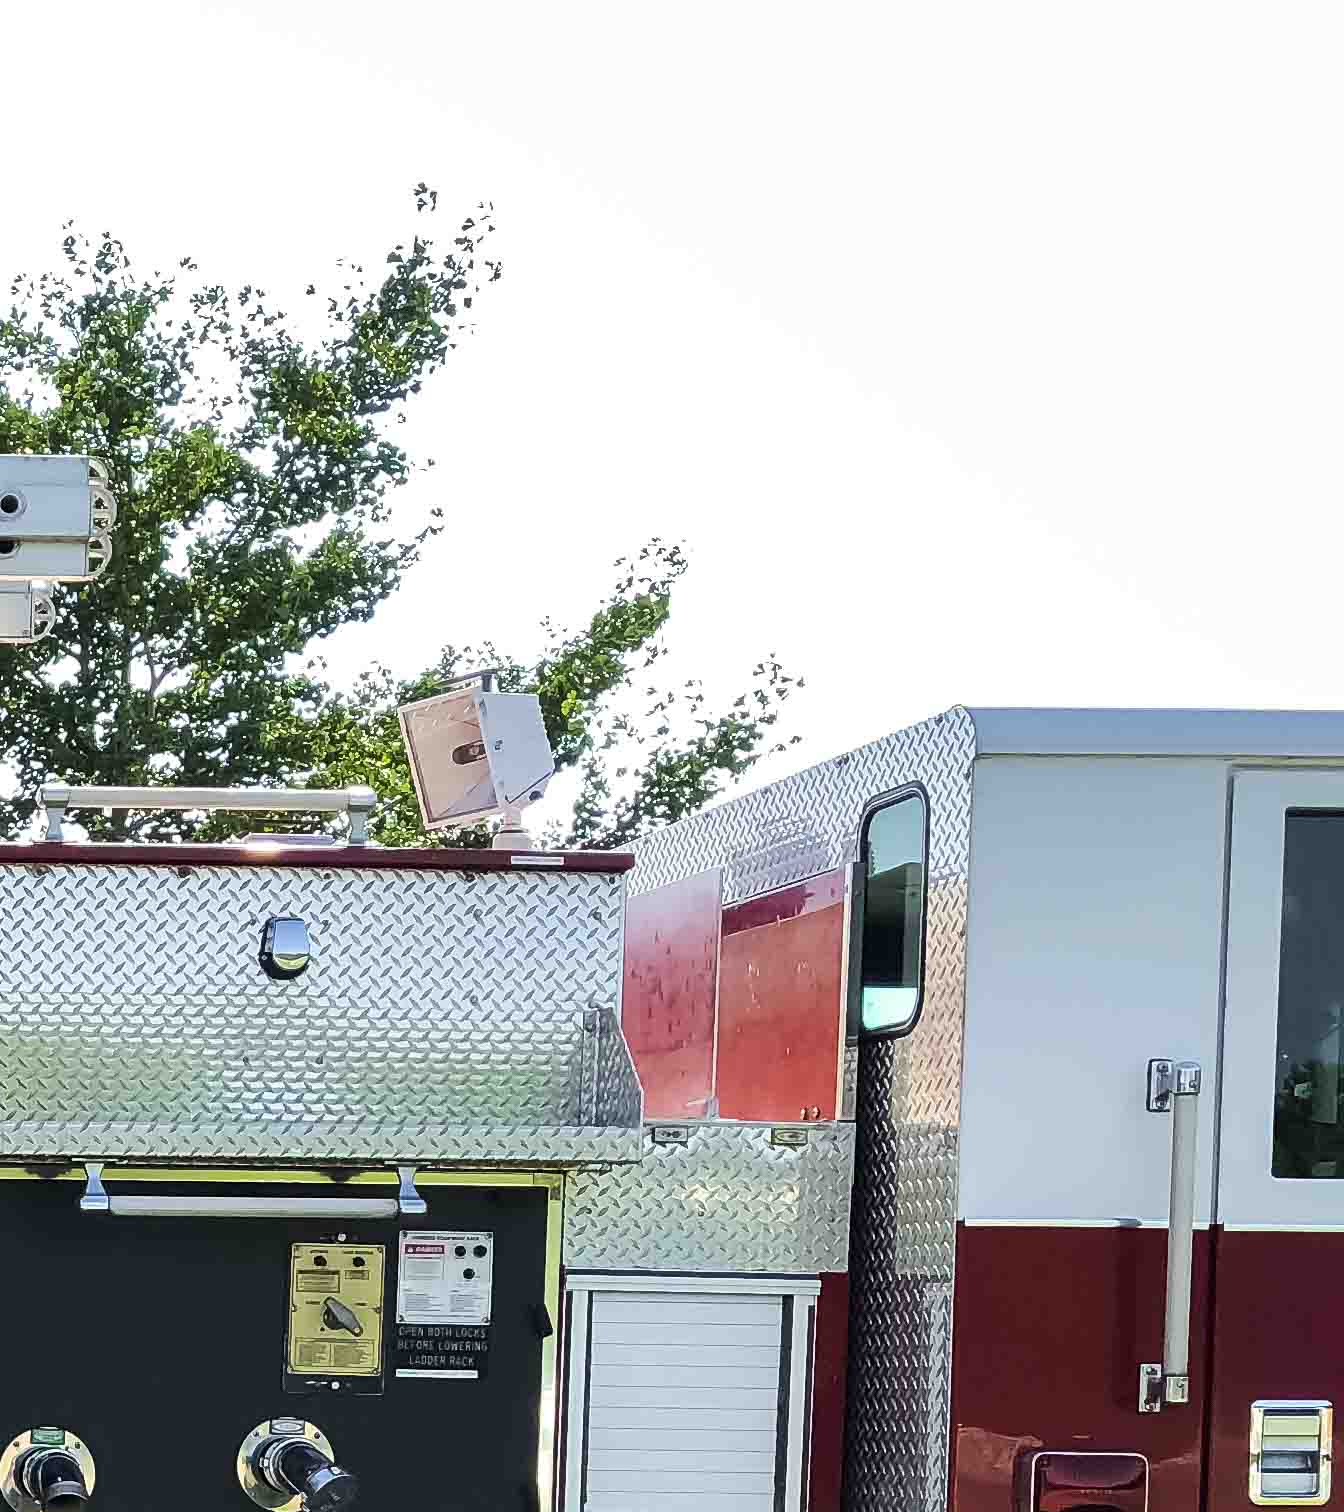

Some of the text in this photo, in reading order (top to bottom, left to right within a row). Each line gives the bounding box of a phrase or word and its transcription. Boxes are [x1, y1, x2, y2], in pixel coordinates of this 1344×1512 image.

[427, 1327, 452, 1337] BOTH
[455, 1327, 486, 1339] LOCKS
[438, 1340, 488, 1352] LOWERING
[409, 1354, 475, 1367] LADDER RACK
